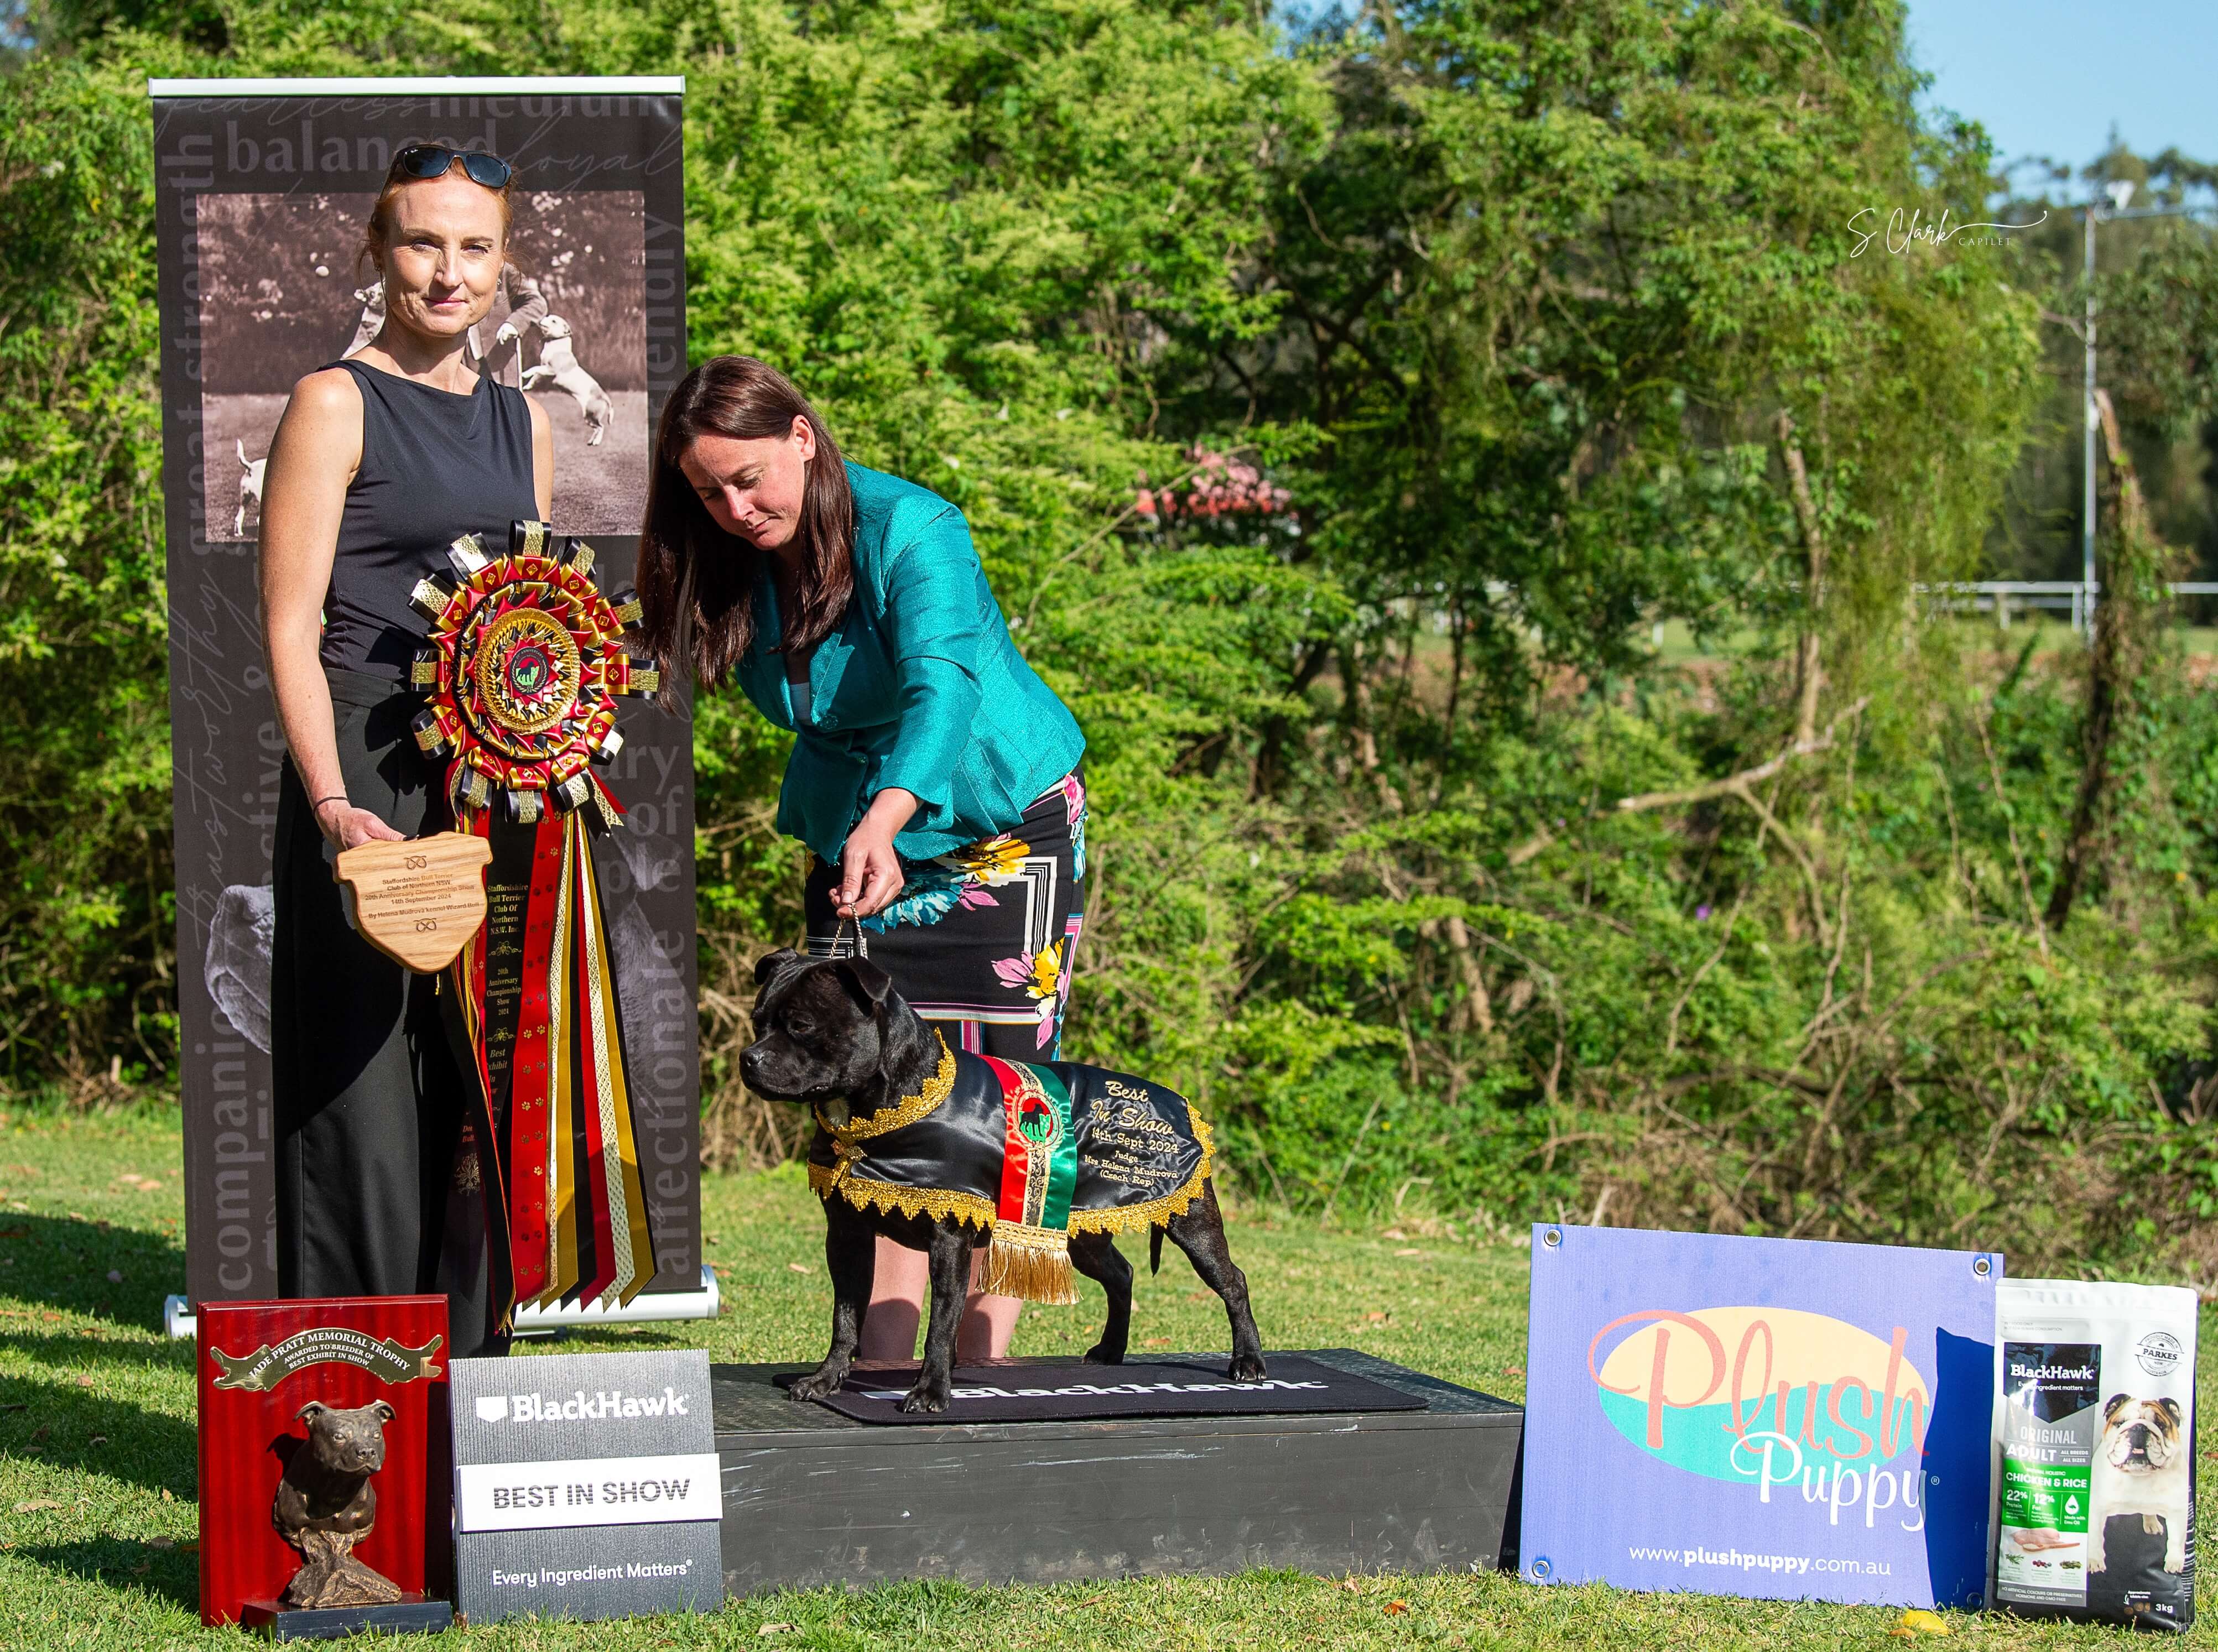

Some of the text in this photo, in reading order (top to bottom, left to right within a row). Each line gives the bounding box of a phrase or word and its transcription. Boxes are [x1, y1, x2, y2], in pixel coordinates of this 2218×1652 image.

[382, 877, 420, 885] Staffordshire
[487, 884, 528, 893] Staffordshire
[379, 891, 414, 899] Anniversary
[415, 887, 457, 895] Championship
[489, 895, 501, 903] Bull
[492, 916, 518, 924] Northern
[489, 978, 518, 987] Anniversary
[487, 986, 521, 997] Championship
[490, 1049, 506, 1058] Best
[1105, 1081, 1149, 1102] Best
[1091, 1099, 1174, 1134] In Show
[1092, 1127, 1180, 1154] 14th Sept 2024
[1115, 1150, 1138, 1164] Judge
[1085, 1155, 1178, 1179] Mrs Helena Mudrova
[1100, 1169, 1154, 1187] (Czech Rep)
[249, 1332, 411, 1378] JADE PRATT MEMORIAL TROPHY
[284, 1344, 318, 1364] AWARDED
[332, 1344, 364, 1356] BREEDER
[365, 1352, 375, 1360] OF
[288, 1358, 306, 1369] BEST
[306, 1352, 336, 1363] EXHIBIT
[347, 1353, 369, 1366] SHOW
[2143, 1348, 2178, 1360] PARKES
[1588, 1309, 1930, 1458] Plush
[2021, 1426, 2077, 1444] ORIGINAL
[2006, 1443, 2057, 1462] ADULT
[2006, 1472, 2087, 1488] CHICKEN & RICE
[493, 1478, 690, 1509] BEST IN SHOW
[2007, 1489, 2055, 1505] 22% 12%
[1629, 1547, 1891, 1576] www.plushpuppy.com.au
[492, 1570, 537, 1587] Every
[542, 1565, 623, 1586] Ingredient
[2155, 1603, 2173, 1614] 3kg
